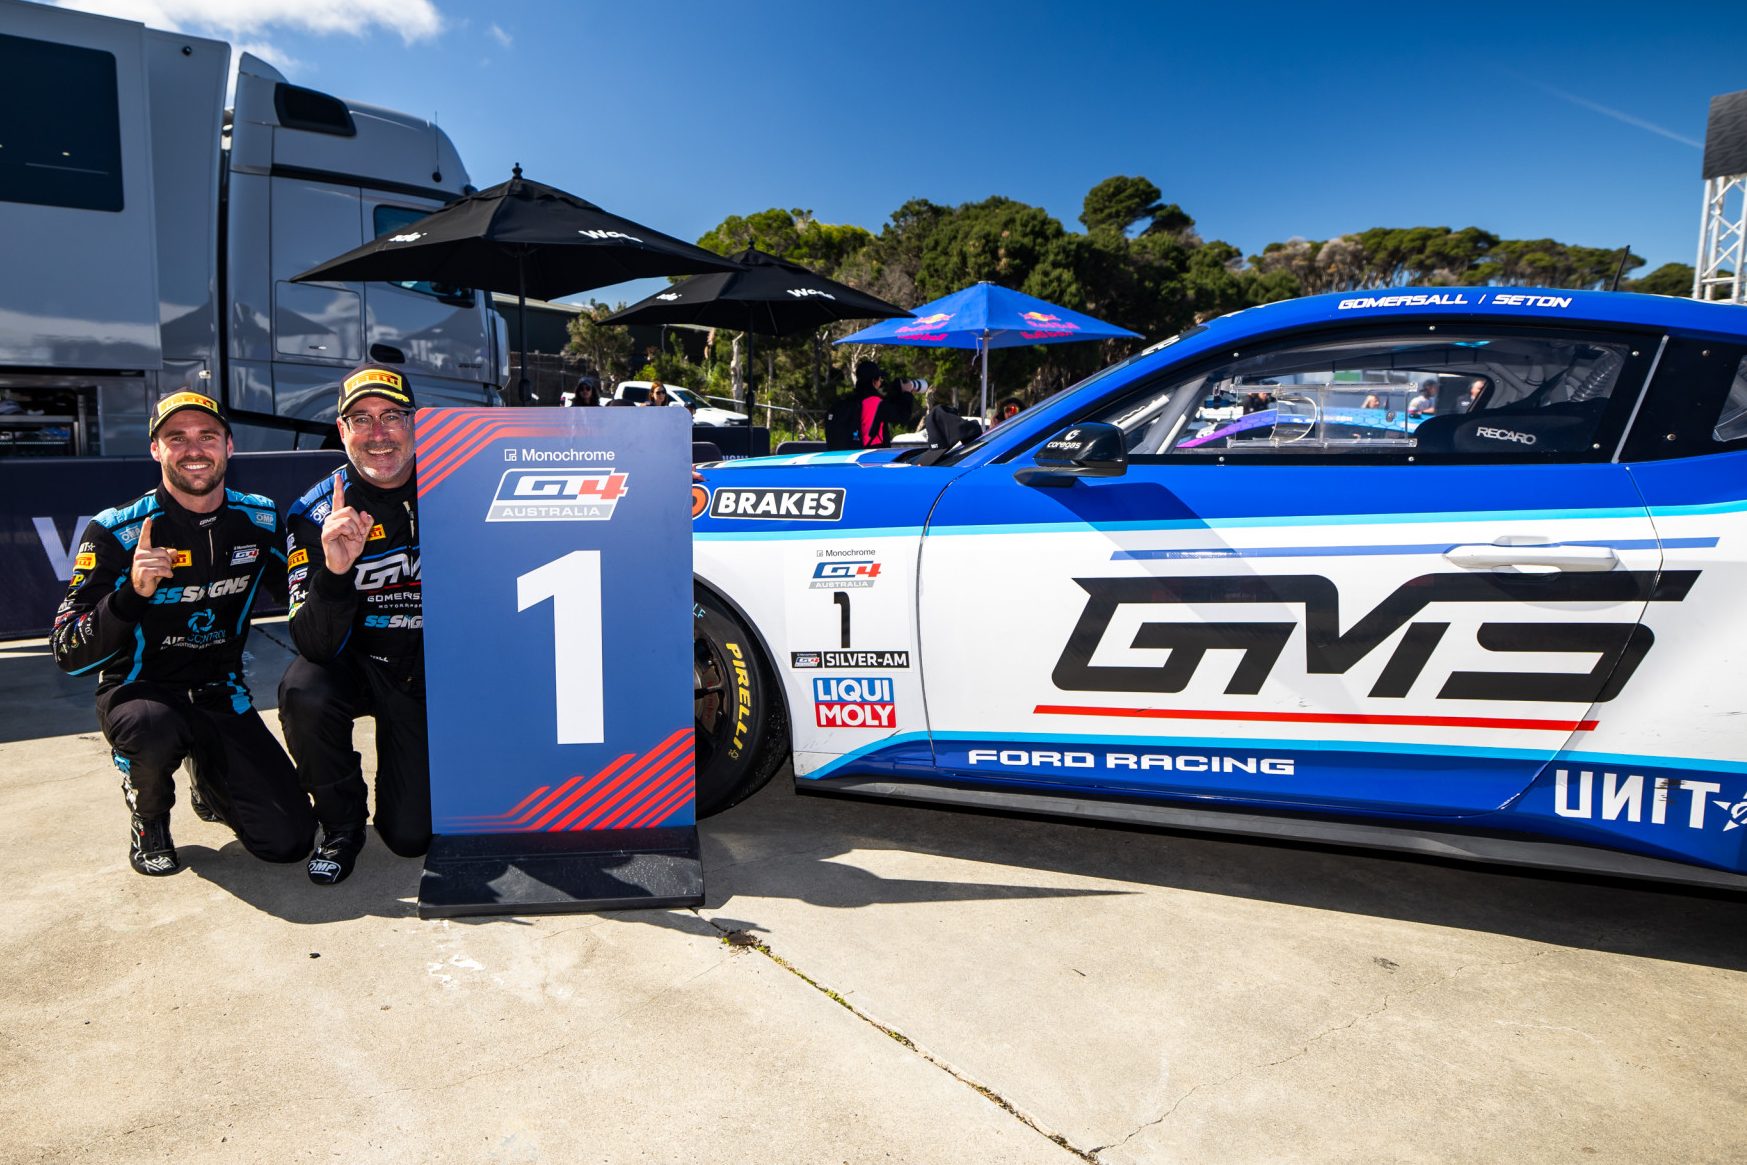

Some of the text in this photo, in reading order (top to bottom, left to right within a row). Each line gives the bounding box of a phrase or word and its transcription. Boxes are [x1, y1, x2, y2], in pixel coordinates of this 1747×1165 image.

[1338, 294, 1468, 309] GOMERSALL
[1492, 294, 1573, 307] SETON
[1047, 441, 1082, 450] coregas
[1475, 426, 1537, 446] RECARO
[522, 448, 615, 461] Monochrome
[513, 474, 628, 500] GT4
[502, 506, 600, 517] AUSTRALIA
[716, 491, 837, 517] BRAKES
[256, 513, 274, 523] OMP
[825, 549, 876, 558] Monochrome
[815, 561, 882, 579] GT4
[815, 580, 869, 589] AUSTRALIA
[367, 591, 422, 603] GOMERS
[833, 591, 851, 649] 1
[1051, 569, 1702, 704] GMS
[516, 549, 605, 745] 1
[826, 652, 908, 667] SILVER-AM
[725, 642, 751, 751] PIRELLI
[816, 678, 891, 703] LIQUI
[818, 704, 894, 726] MOLY
[968, 749, 1295, 776] FORD RACING
[1554, 769, 1721, 830] UNIT
[308, 862, 338, 872] OMP
